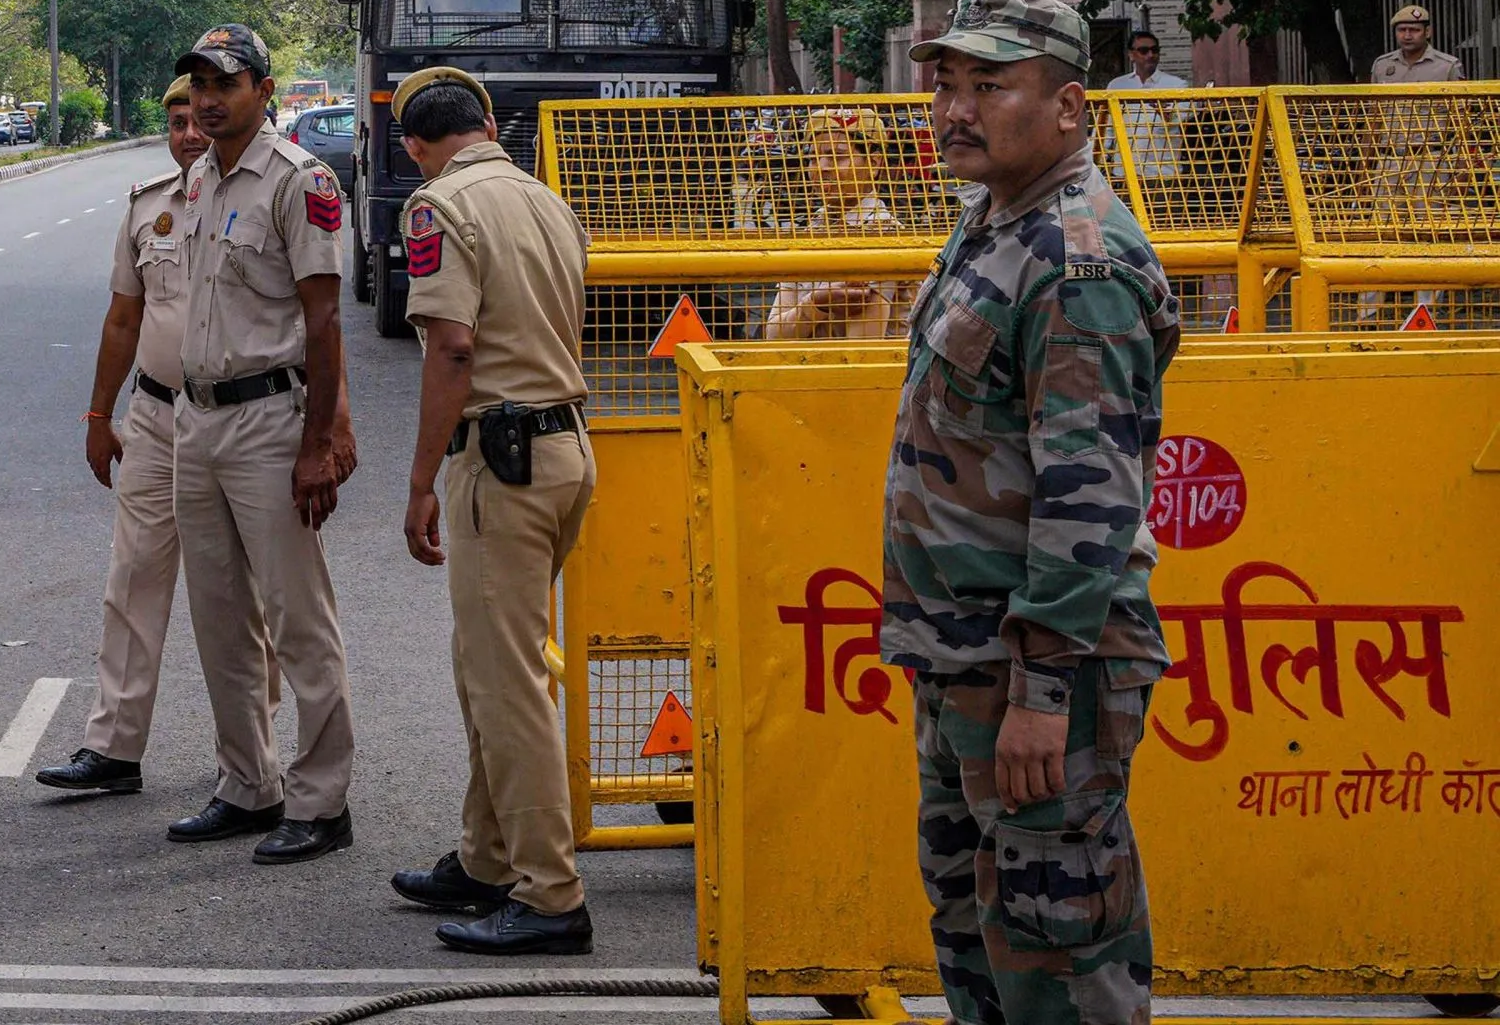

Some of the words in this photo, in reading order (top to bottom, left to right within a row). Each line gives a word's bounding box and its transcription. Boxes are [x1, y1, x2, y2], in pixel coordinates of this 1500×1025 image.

[600, 80, 681, 99] POLICE
[1071, 264, 1106, 277] TSR
[1157, 437, 1206, 476] SD
[1237, 770, 1331, 817] थाना
